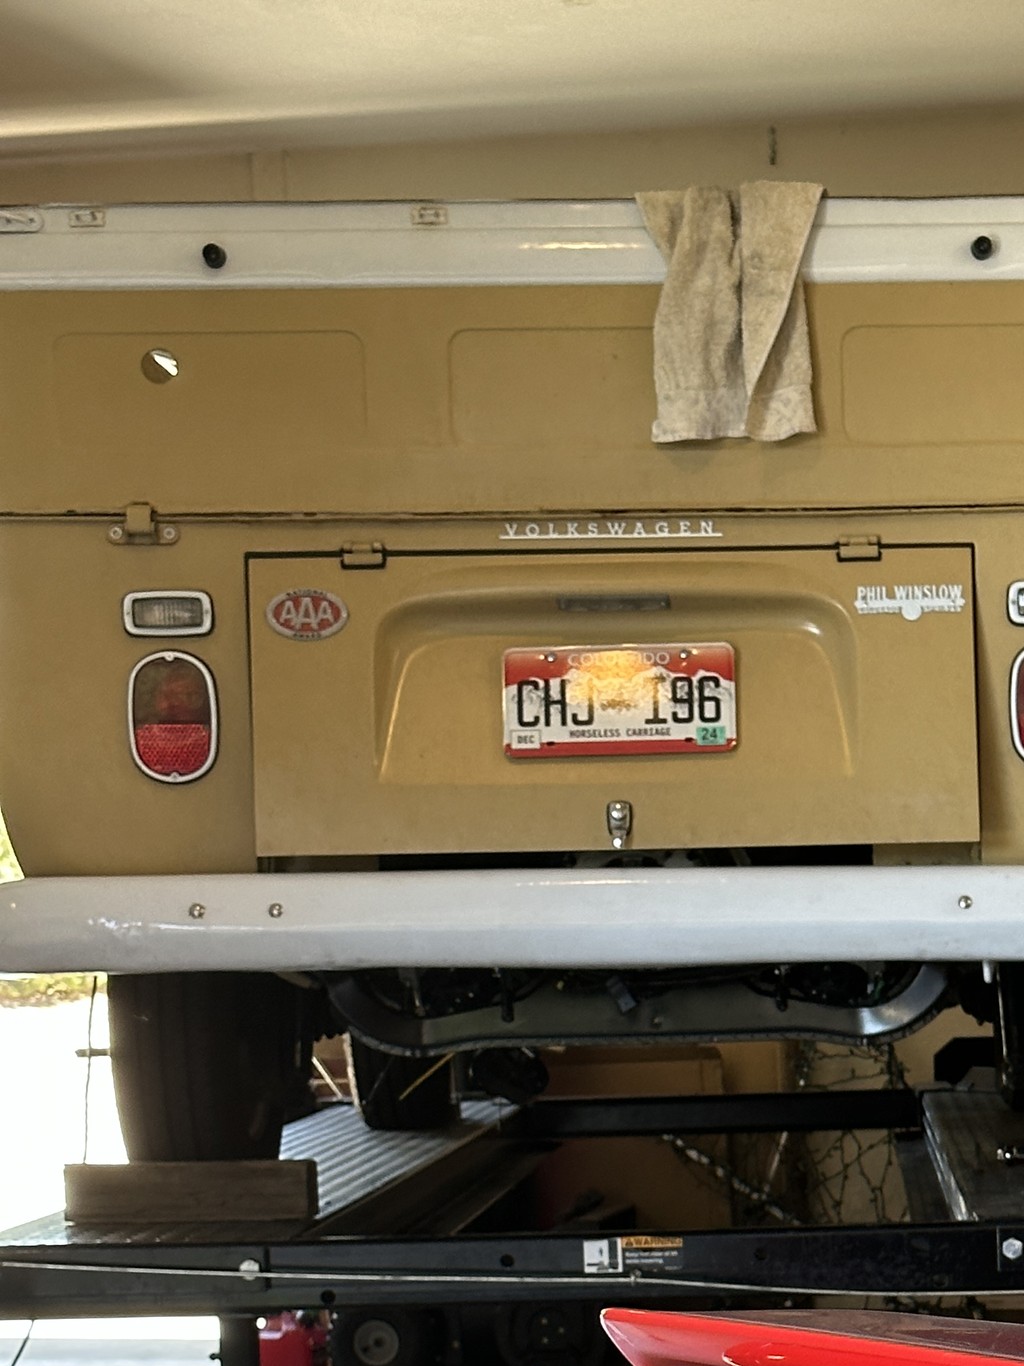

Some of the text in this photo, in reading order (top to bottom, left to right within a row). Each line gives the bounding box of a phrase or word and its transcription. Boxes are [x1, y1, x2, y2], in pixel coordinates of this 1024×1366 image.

[505, 520, 714, 537] VOLKSWAGEN
[857, 585, 962, 602] PHIL WINSLOW
[279, 597, 335, 630] AAA
[567, 652, 670, 668] COLODO
[517, 679, 595, 727] CHJ
[517, 735, 535, 744] DEC
[569, 727, 671, 739] HORSELESS CARRIAGE
[701, 728, 717, 740] 24
